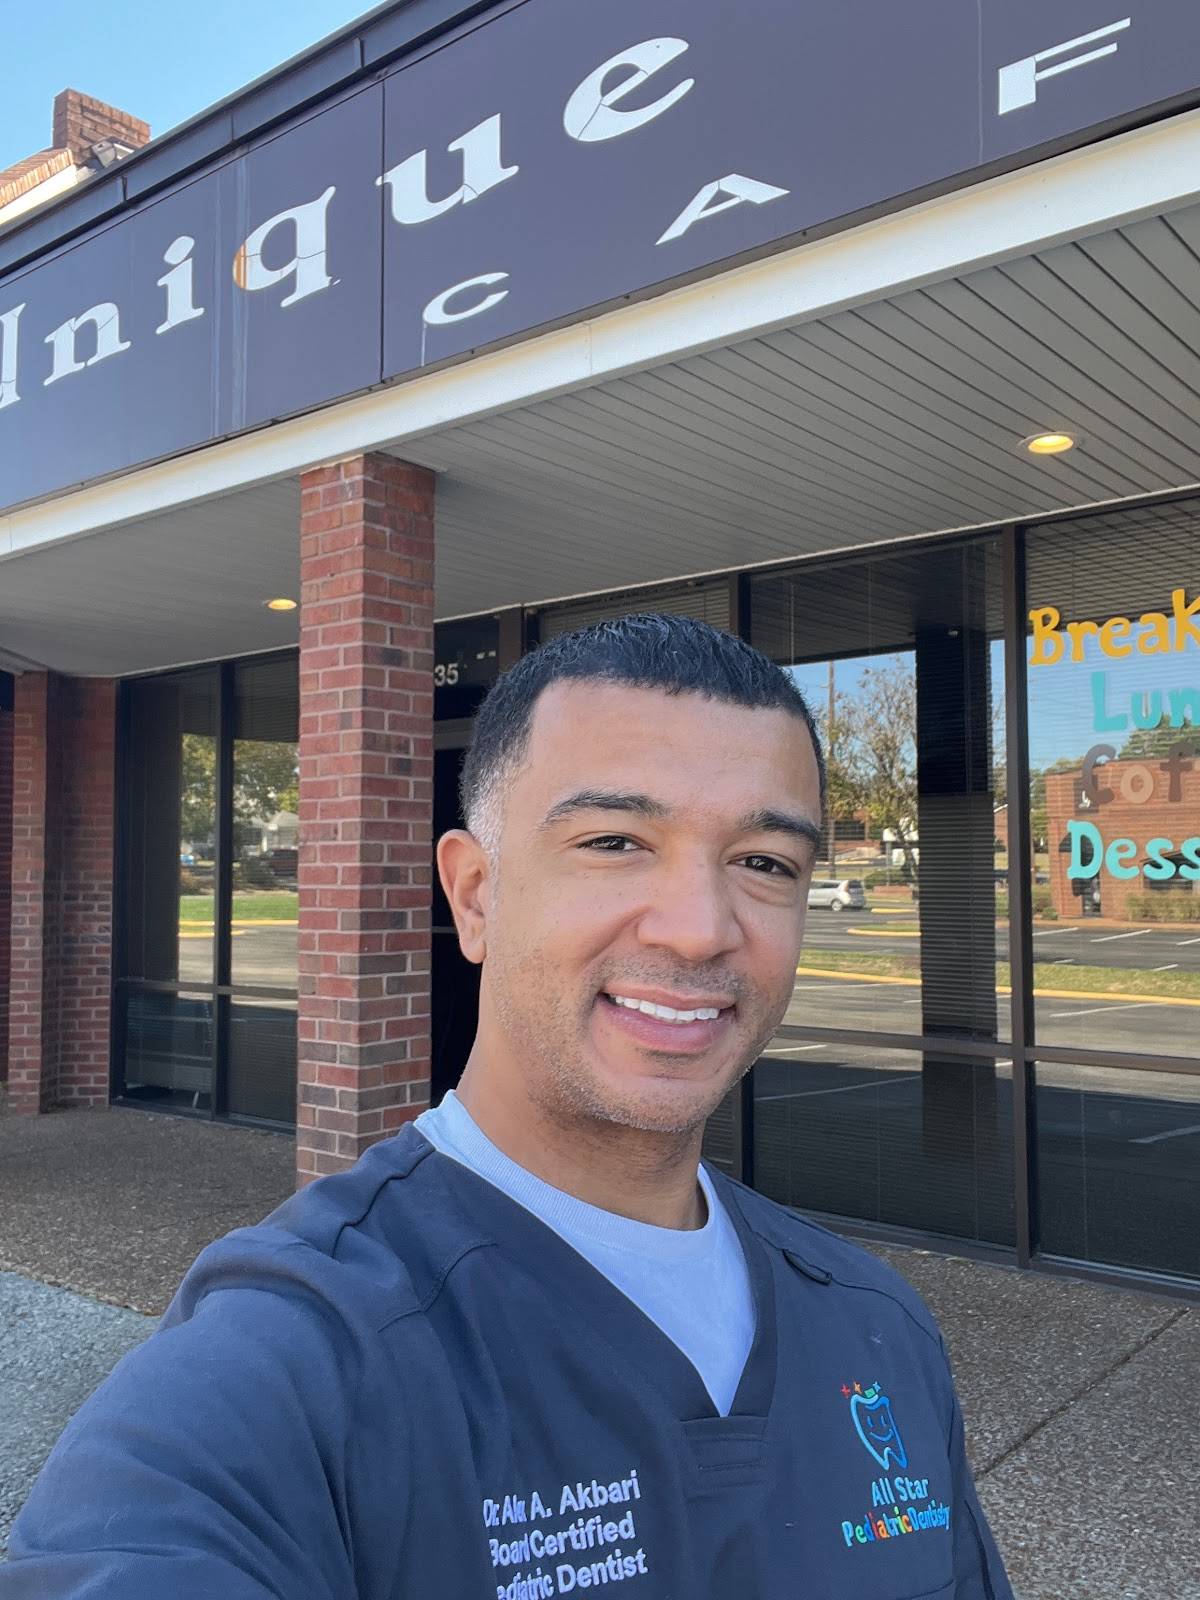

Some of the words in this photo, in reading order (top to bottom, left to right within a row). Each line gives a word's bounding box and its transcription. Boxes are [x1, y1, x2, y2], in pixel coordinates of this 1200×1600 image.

[1029, 588, 1200, 666] Break
[434, 663, 459, 687] 35
[1091, 672, 1200, 732] Lun
[1081, 741, 1200, 806] Cof
[1067, 820, 1200, 880] Dess
[530, 1491, 553, 1521] A.
[559, 1469, 641, 1515] Akbari
[872, 1477, 896, 1507] All
[894, 1476, 929, 1502] Star
[530, 1510, 636, 1559] Certified
[841, 1505, 913, 1547] Pediatric
[556, 1548, 649, 1594] Dentist
